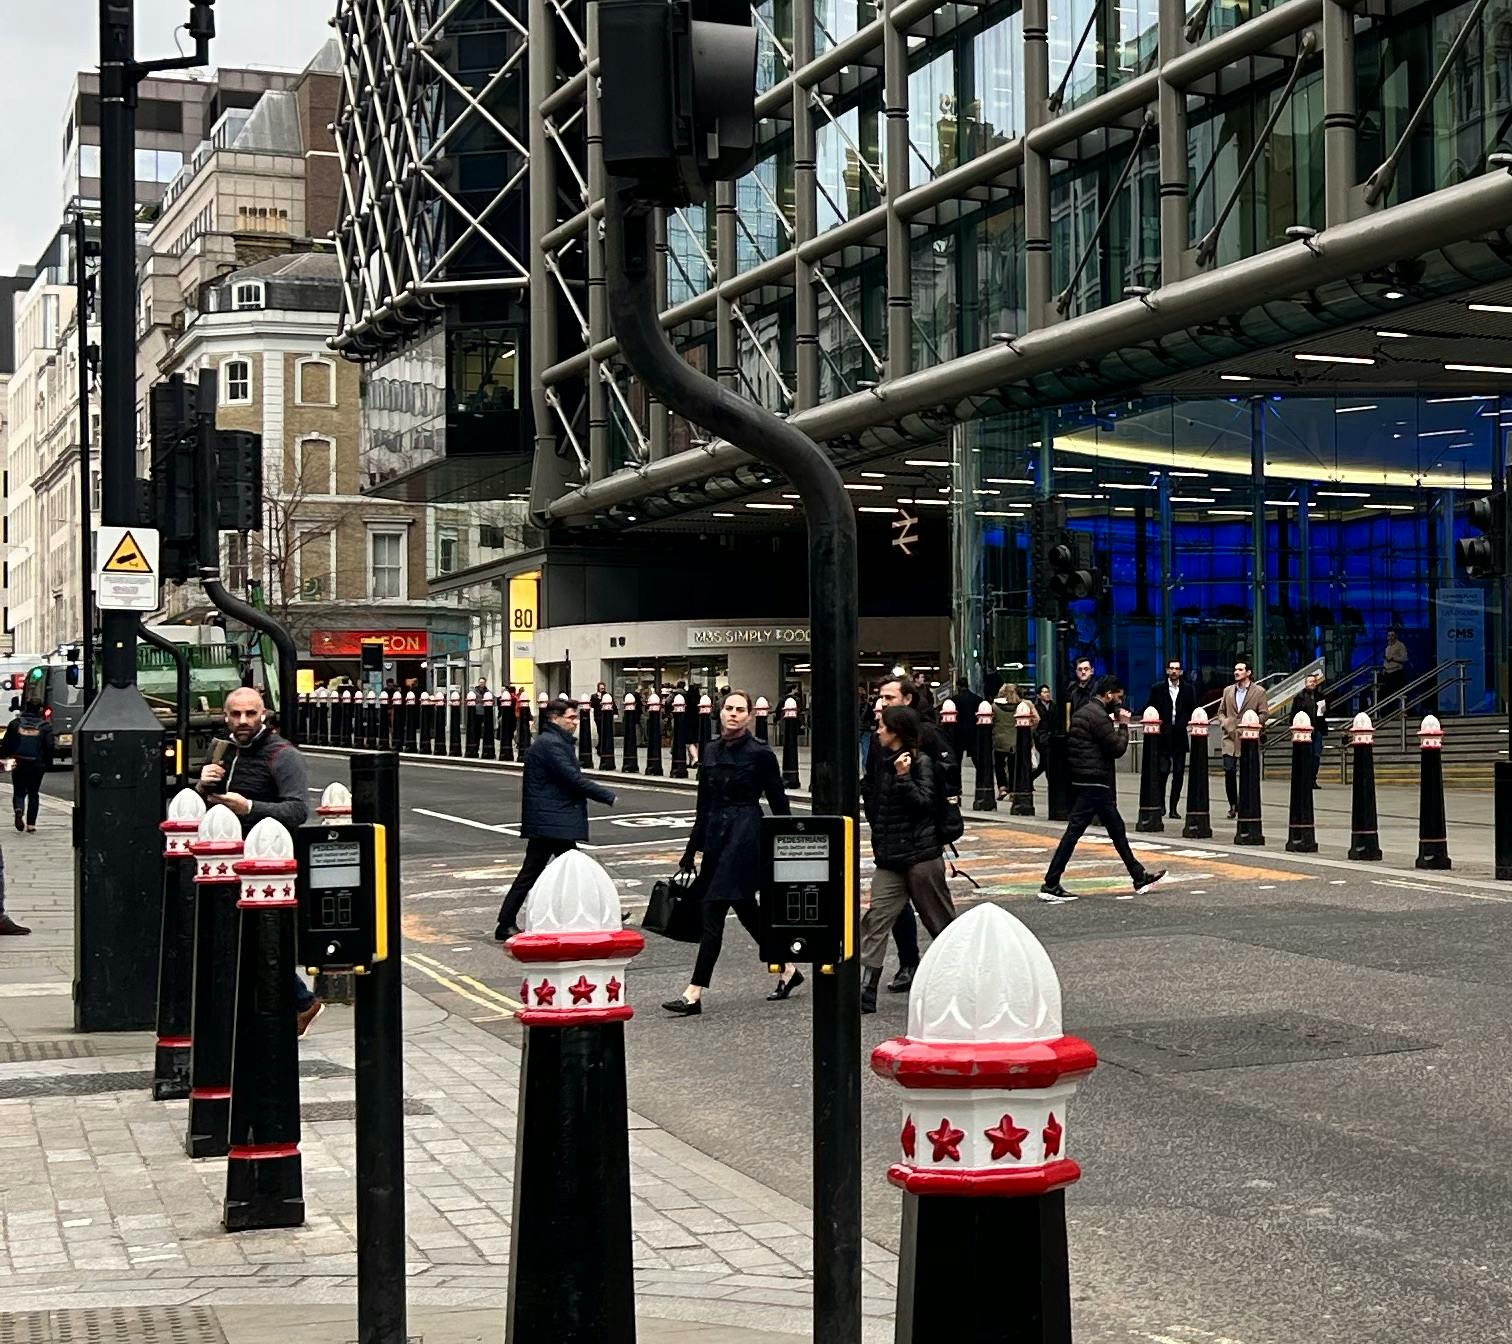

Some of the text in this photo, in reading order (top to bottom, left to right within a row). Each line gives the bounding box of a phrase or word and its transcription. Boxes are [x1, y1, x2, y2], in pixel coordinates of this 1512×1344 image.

[514, 609, 533, 628] 80
[725, 629, 772, 643] SIMPLY
[1447, 628, 1475, 640] CMS
